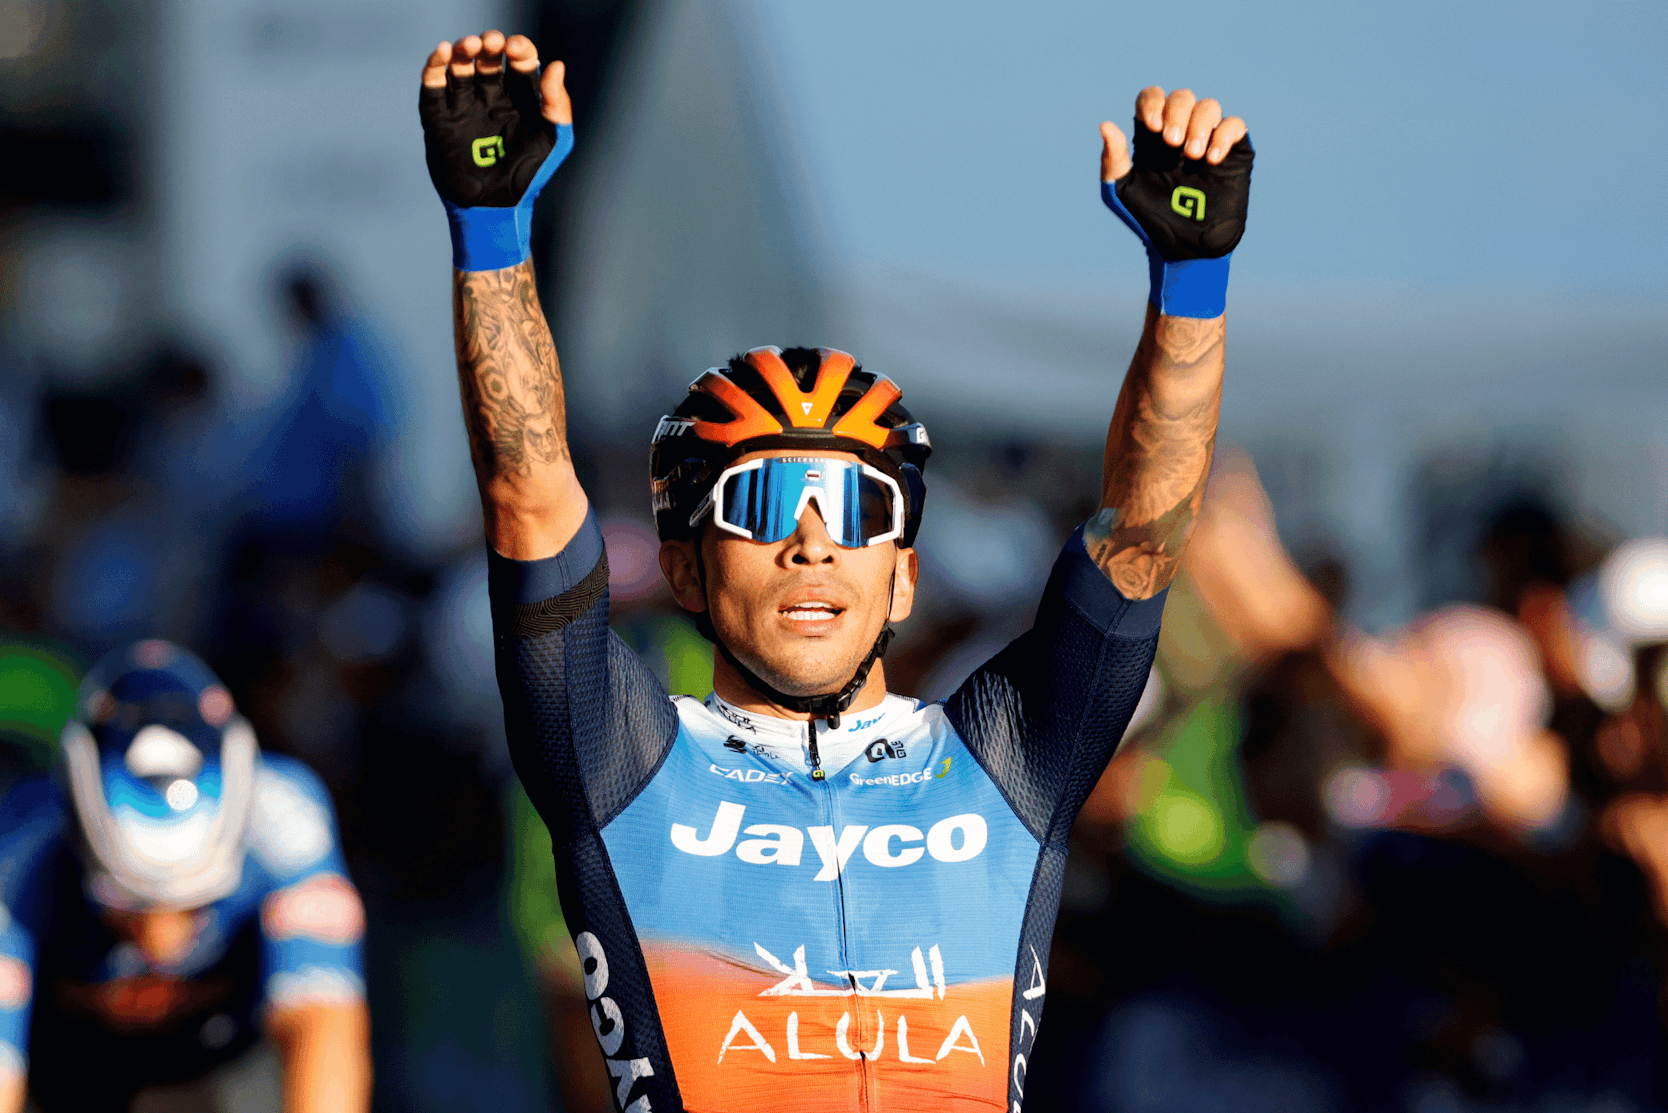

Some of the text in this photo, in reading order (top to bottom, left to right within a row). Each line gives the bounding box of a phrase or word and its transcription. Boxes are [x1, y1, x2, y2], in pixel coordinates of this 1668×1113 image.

[709, 763, 793, 785] CADEX
[849, 767, 933, 786] GreenEDGE
[670, 800, 988, 882] Jayco
[716, 1009, 986, 1068] ALULA
